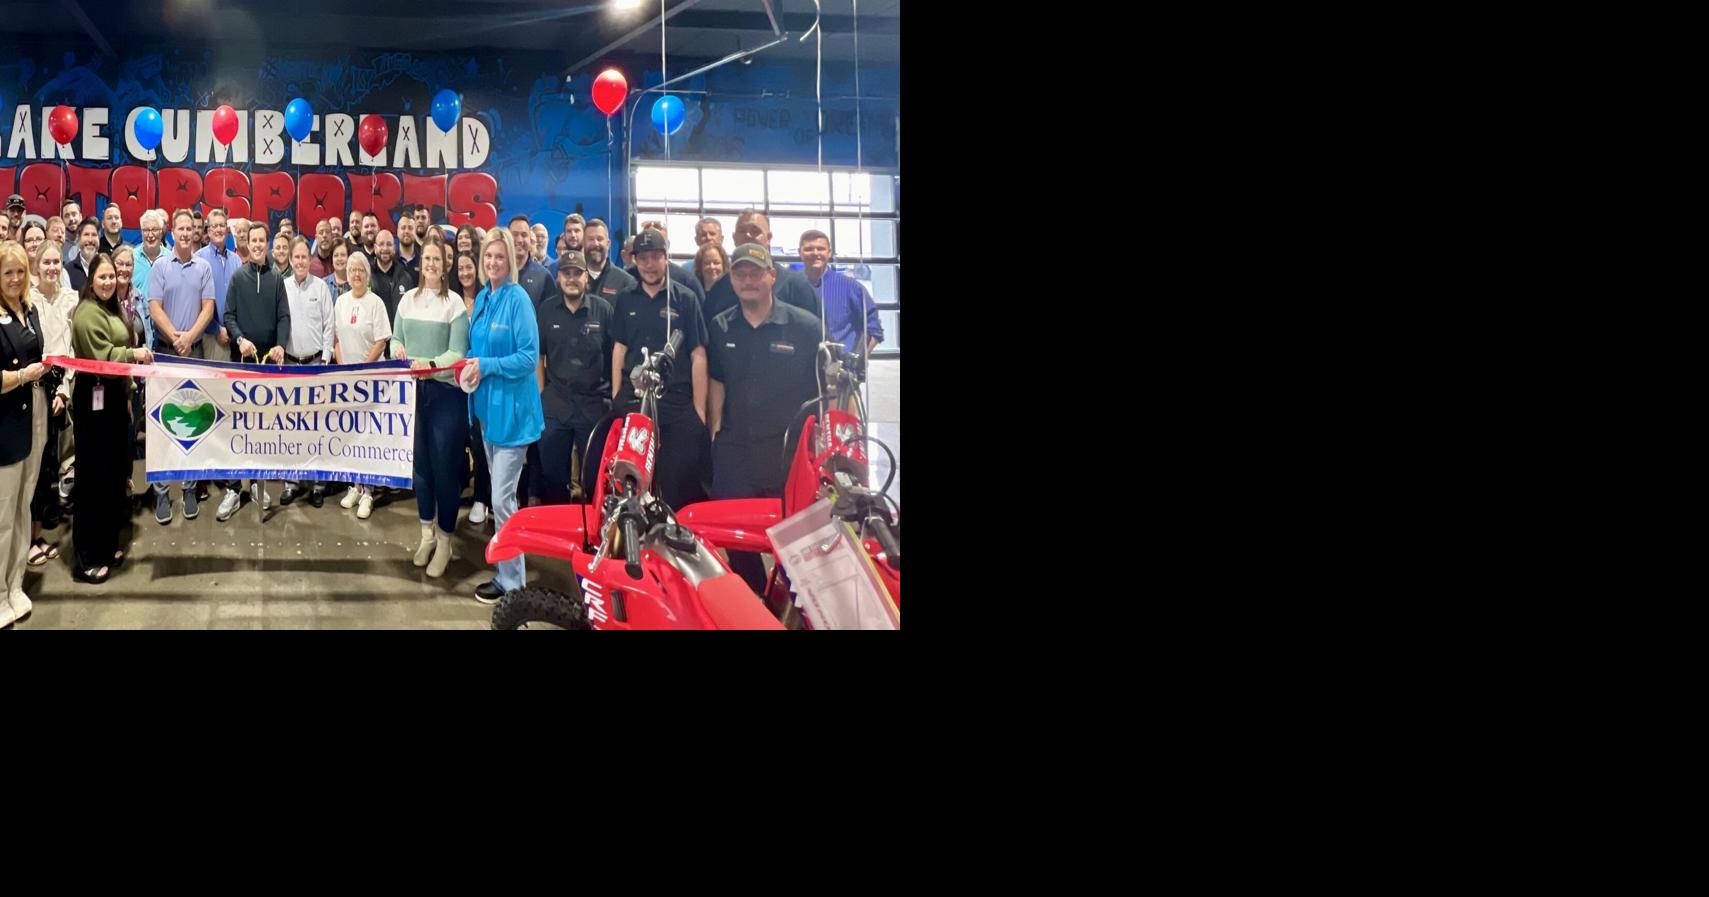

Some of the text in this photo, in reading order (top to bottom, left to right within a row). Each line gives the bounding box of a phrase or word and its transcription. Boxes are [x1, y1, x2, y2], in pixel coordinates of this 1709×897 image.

[0, 104, 109, 160] AKE
[231, 379, 413, 407] SOMERSET
[232, 409, 413, 437] PULASKI COUNTY
[230, 434, 414, 463] Chamber of Commerce
